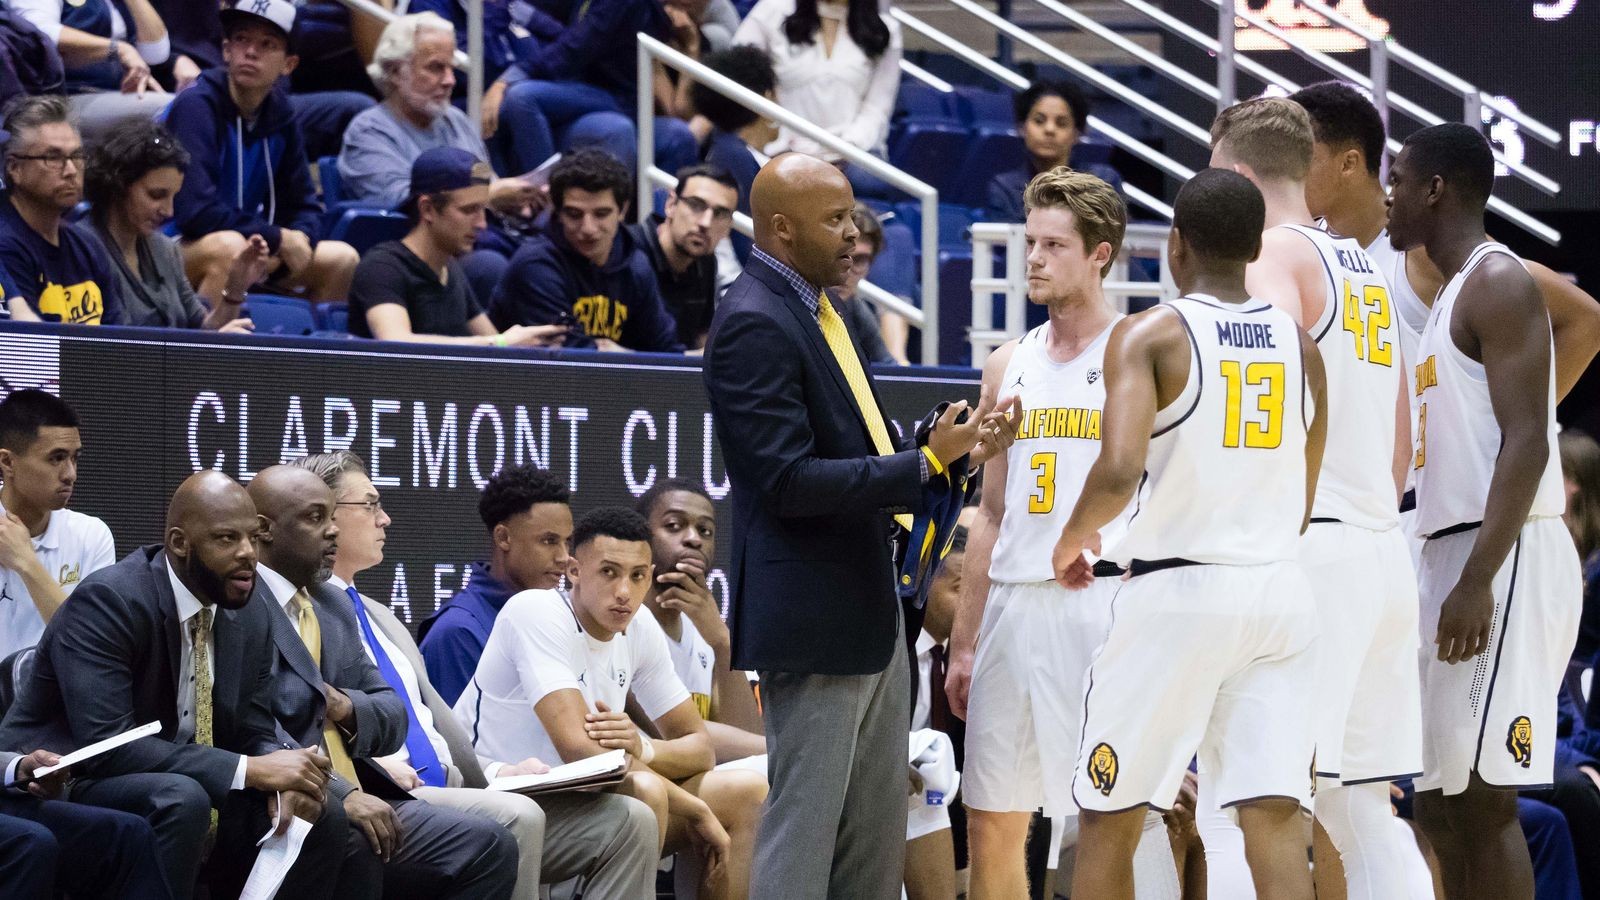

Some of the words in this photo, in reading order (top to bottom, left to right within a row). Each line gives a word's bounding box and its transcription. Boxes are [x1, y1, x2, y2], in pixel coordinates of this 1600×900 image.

[1215, 320, 1276, 349] MOORE
[1342, 277, 1392, 368] 42
[1003, 407, 1102, 440] LIFORNIA
[1220, 360, 1285, 450] 13
[622, 410, 732, 500] CLU
[1028, 451, 1057, 514] 3
